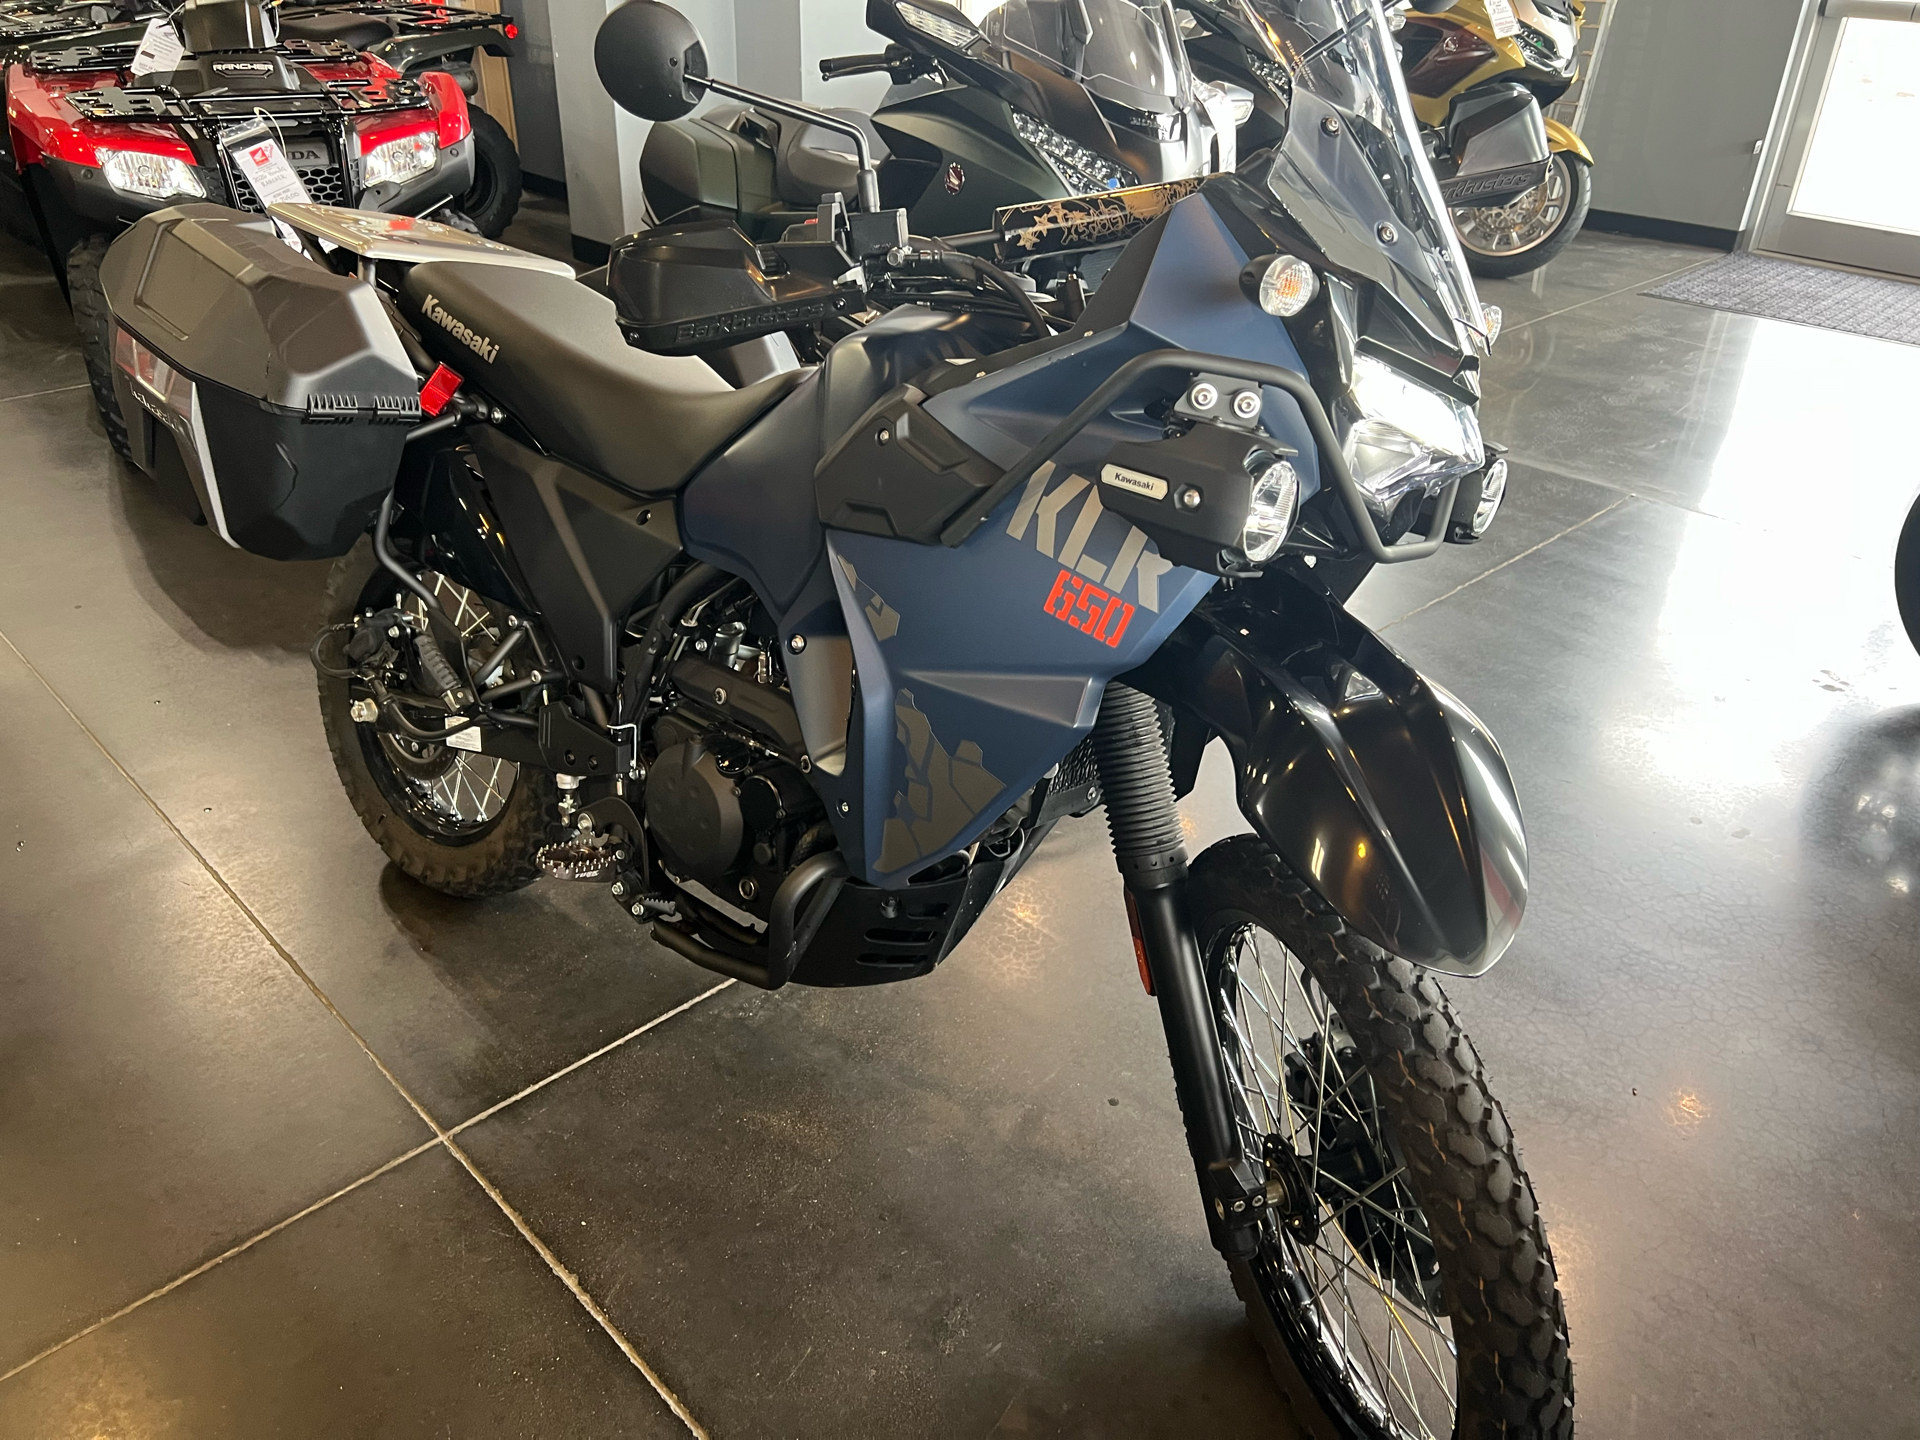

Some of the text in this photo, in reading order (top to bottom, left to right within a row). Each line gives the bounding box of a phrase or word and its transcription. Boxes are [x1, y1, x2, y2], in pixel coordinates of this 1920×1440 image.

[212, 63, 274, 71] RANCHER
[421, 293, 500, 364] Kawasaki
[1114, 472, 1154, 491] Kawasaki
[1005, 459, 1174, 614] KLR
[1043, 569, 1136, 649] 650
